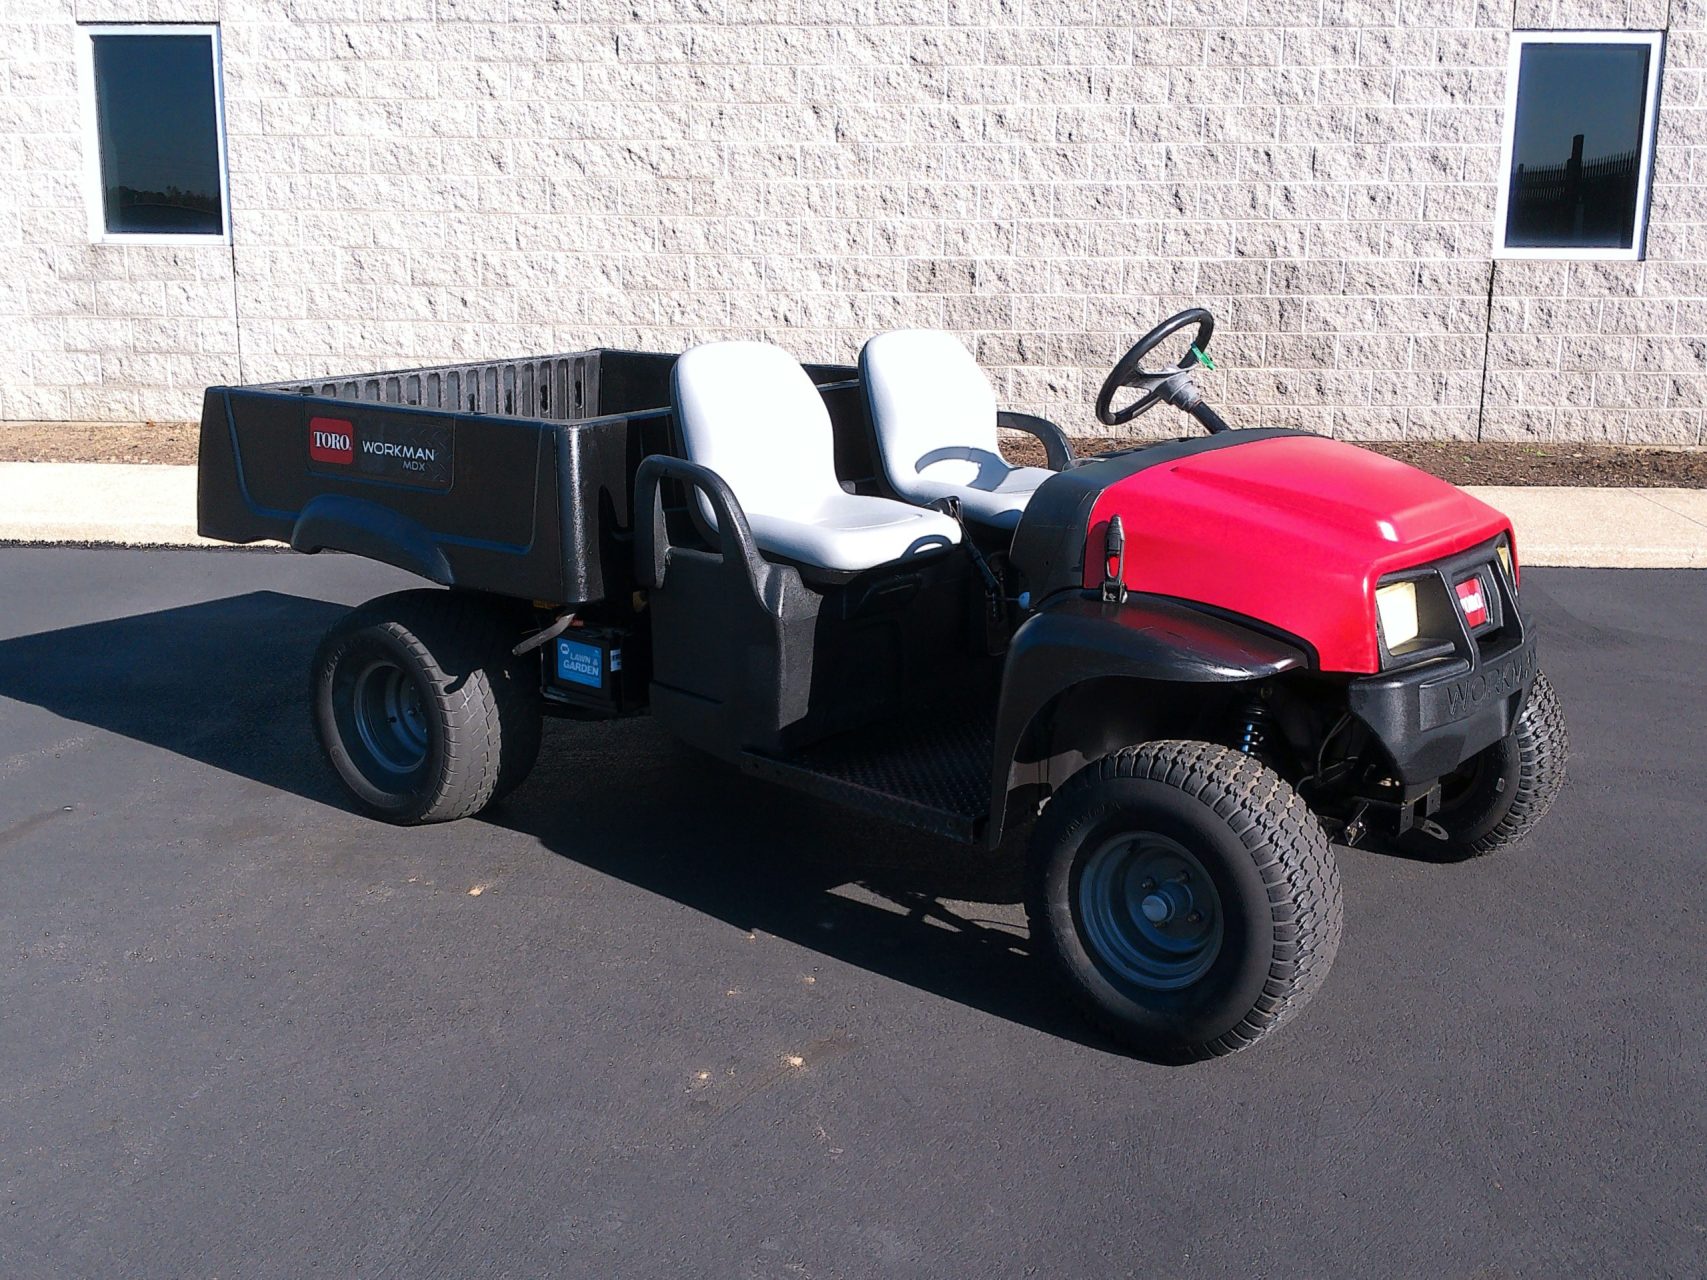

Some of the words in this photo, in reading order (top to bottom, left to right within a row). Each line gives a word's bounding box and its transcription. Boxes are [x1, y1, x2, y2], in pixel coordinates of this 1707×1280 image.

[313, 431, 350, 451] TORO
[362, 440, 435, 461] WORKMAN
[402, 460, 426, 472] MDX
[570, 652, 591, 664] LAWN
[563, 659, 599, 677] GARDEN
